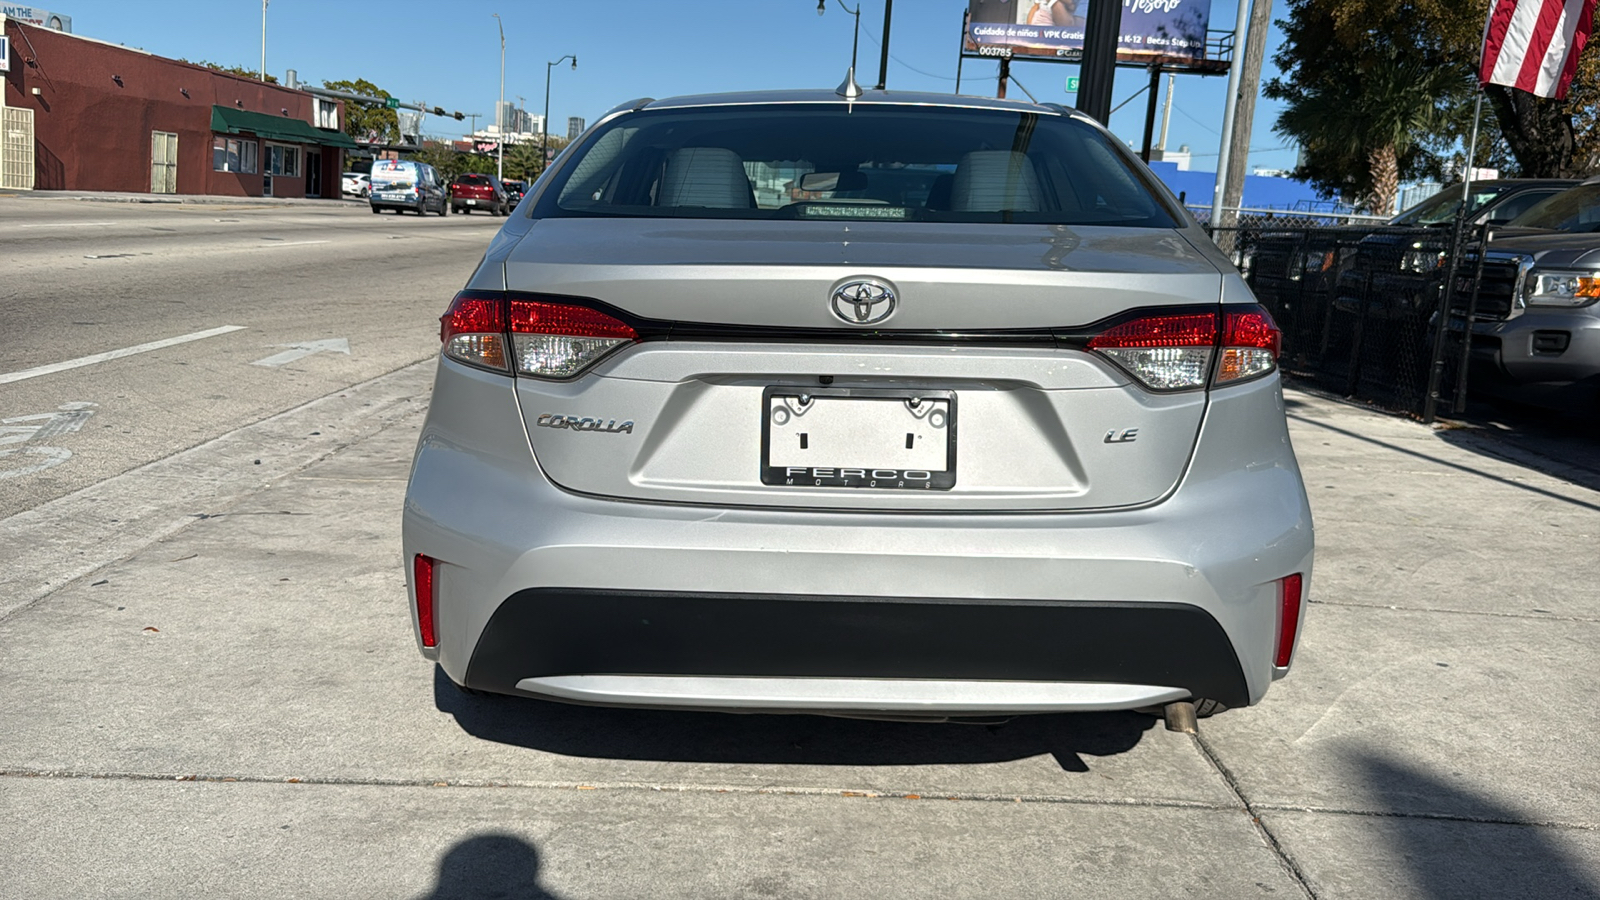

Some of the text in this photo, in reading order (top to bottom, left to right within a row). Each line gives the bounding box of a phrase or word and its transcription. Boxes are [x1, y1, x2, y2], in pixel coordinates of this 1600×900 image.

[3, 6, 32, 18] AM THE
[974, 26, 1085, 40] Cuidado de niños VPK Gratis
[1124, 35, 1142, 44] K-12
[1147, 37, 1170, 46] Becas
[1171, 38, 1188, 48] Step
[979, 47, 1012, 57] 003785
[537, 413, 634, 434] COROLLA
[1104, 428, 1139, 443] LE
[786, 467, 931, 480] FERCO
[786, 479, 931, 489] MOTORS
